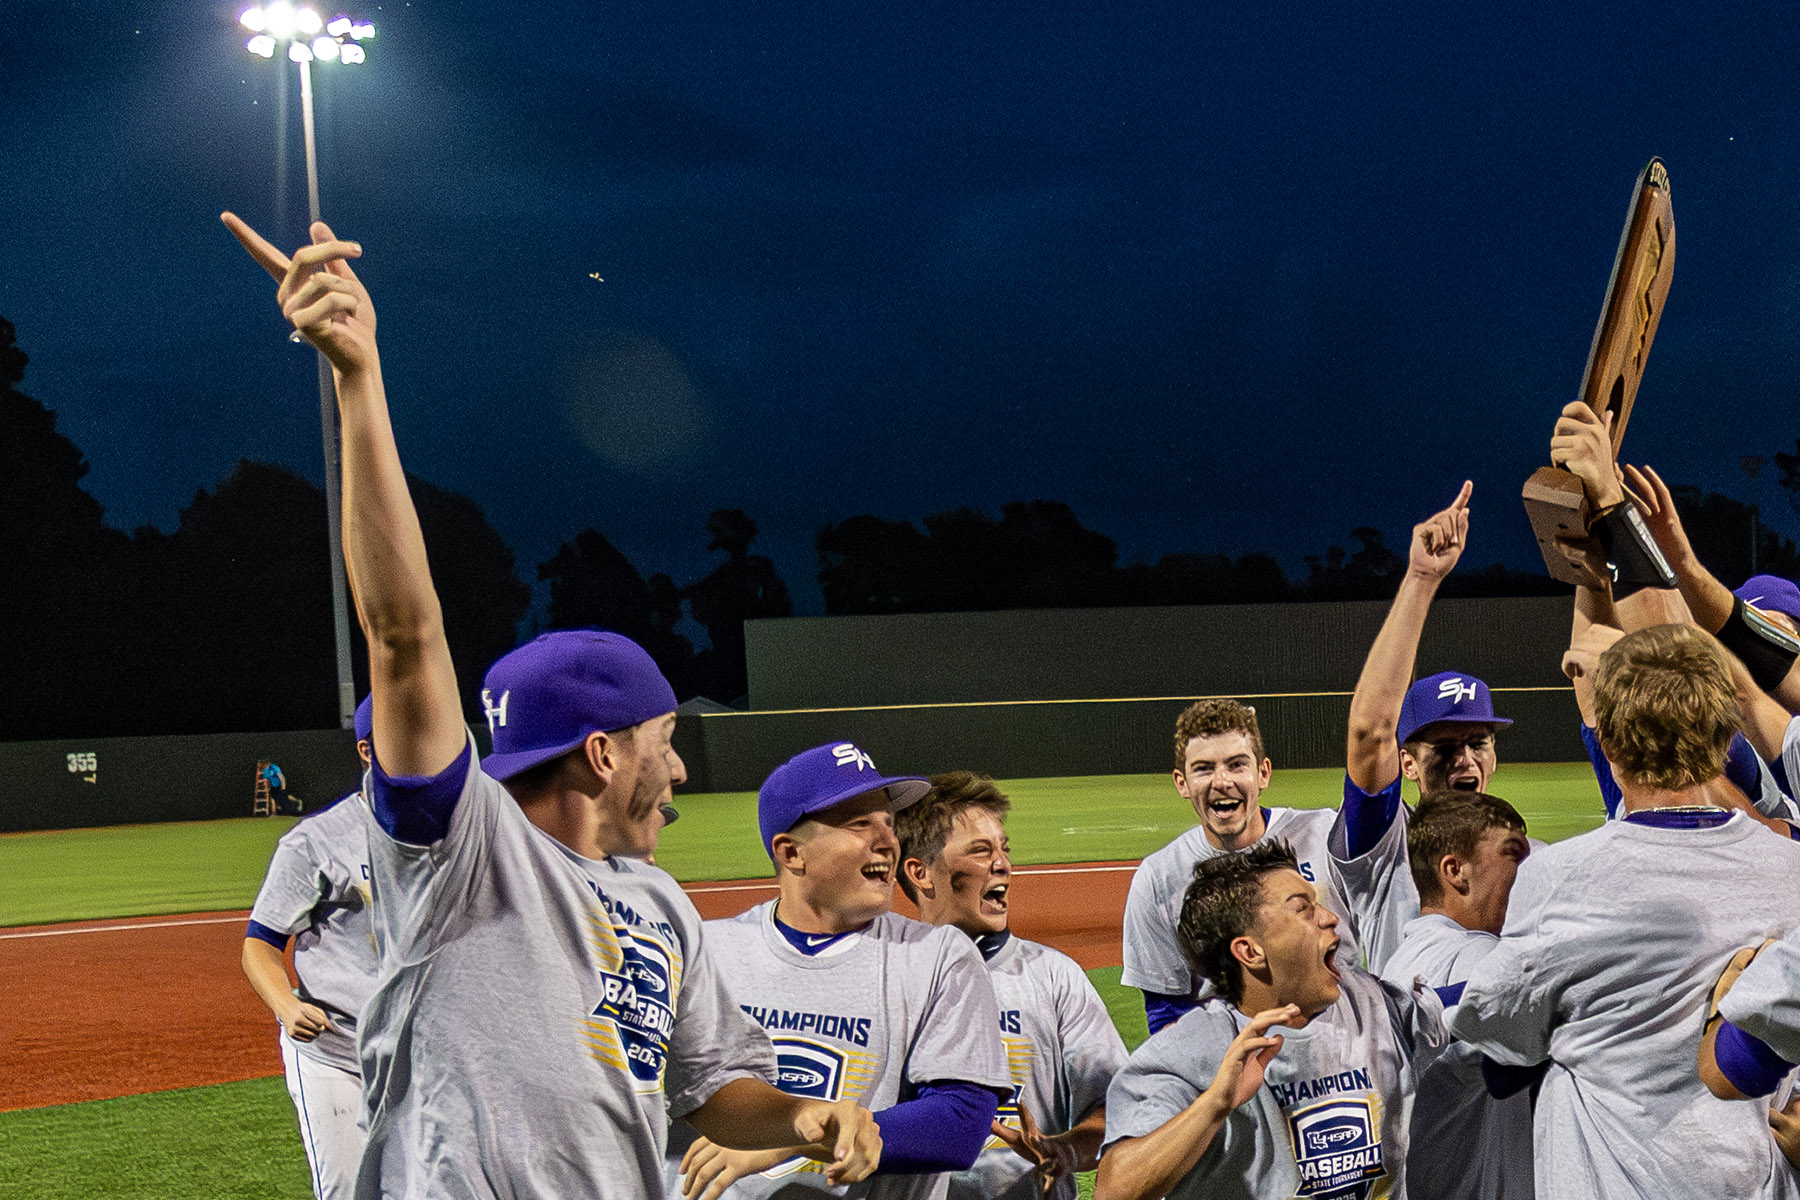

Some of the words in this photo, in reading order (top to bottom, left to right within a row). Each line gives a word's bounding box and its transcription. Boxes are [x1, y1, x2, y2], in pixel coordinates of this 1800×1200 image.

[1437, 677, 1477, 705] SH
[66, 752, 97, 773] 355
[1269, 1066, 1374, 1108] CHAMPION
[1312, 1178, 1331, 1190] STATE
